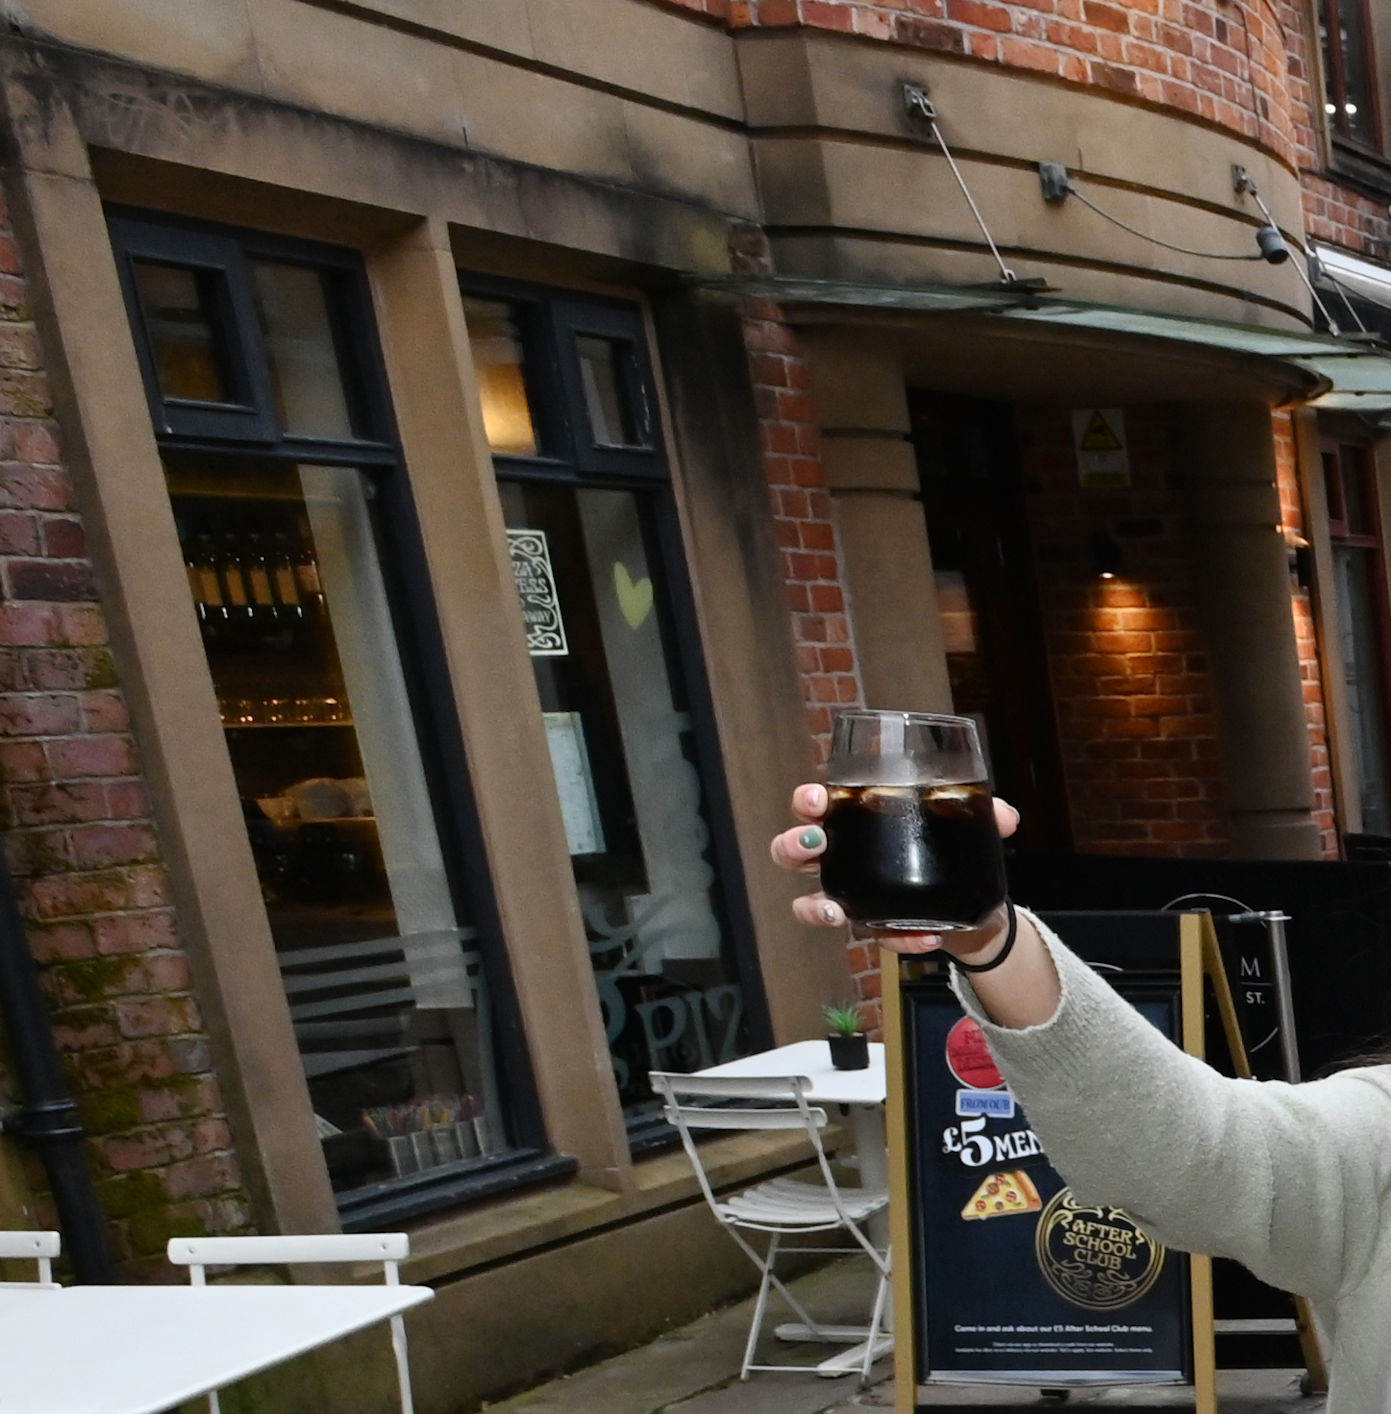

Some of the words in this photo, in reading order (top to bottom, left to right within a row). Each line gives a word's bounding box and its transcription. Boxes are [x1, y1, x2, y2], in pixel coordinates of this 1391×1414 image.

[1246, 992, 1265, 1004] ST.
[942, 1117, 994, 1167] £5
[993, 1129, 1045, 1162] MEN
[1072, 1219, 1133, 1244] AFTER
[1062, 1231, 1137, 1259] SCHOOL
[1074, 1248, 1122, 1270] CLUB
